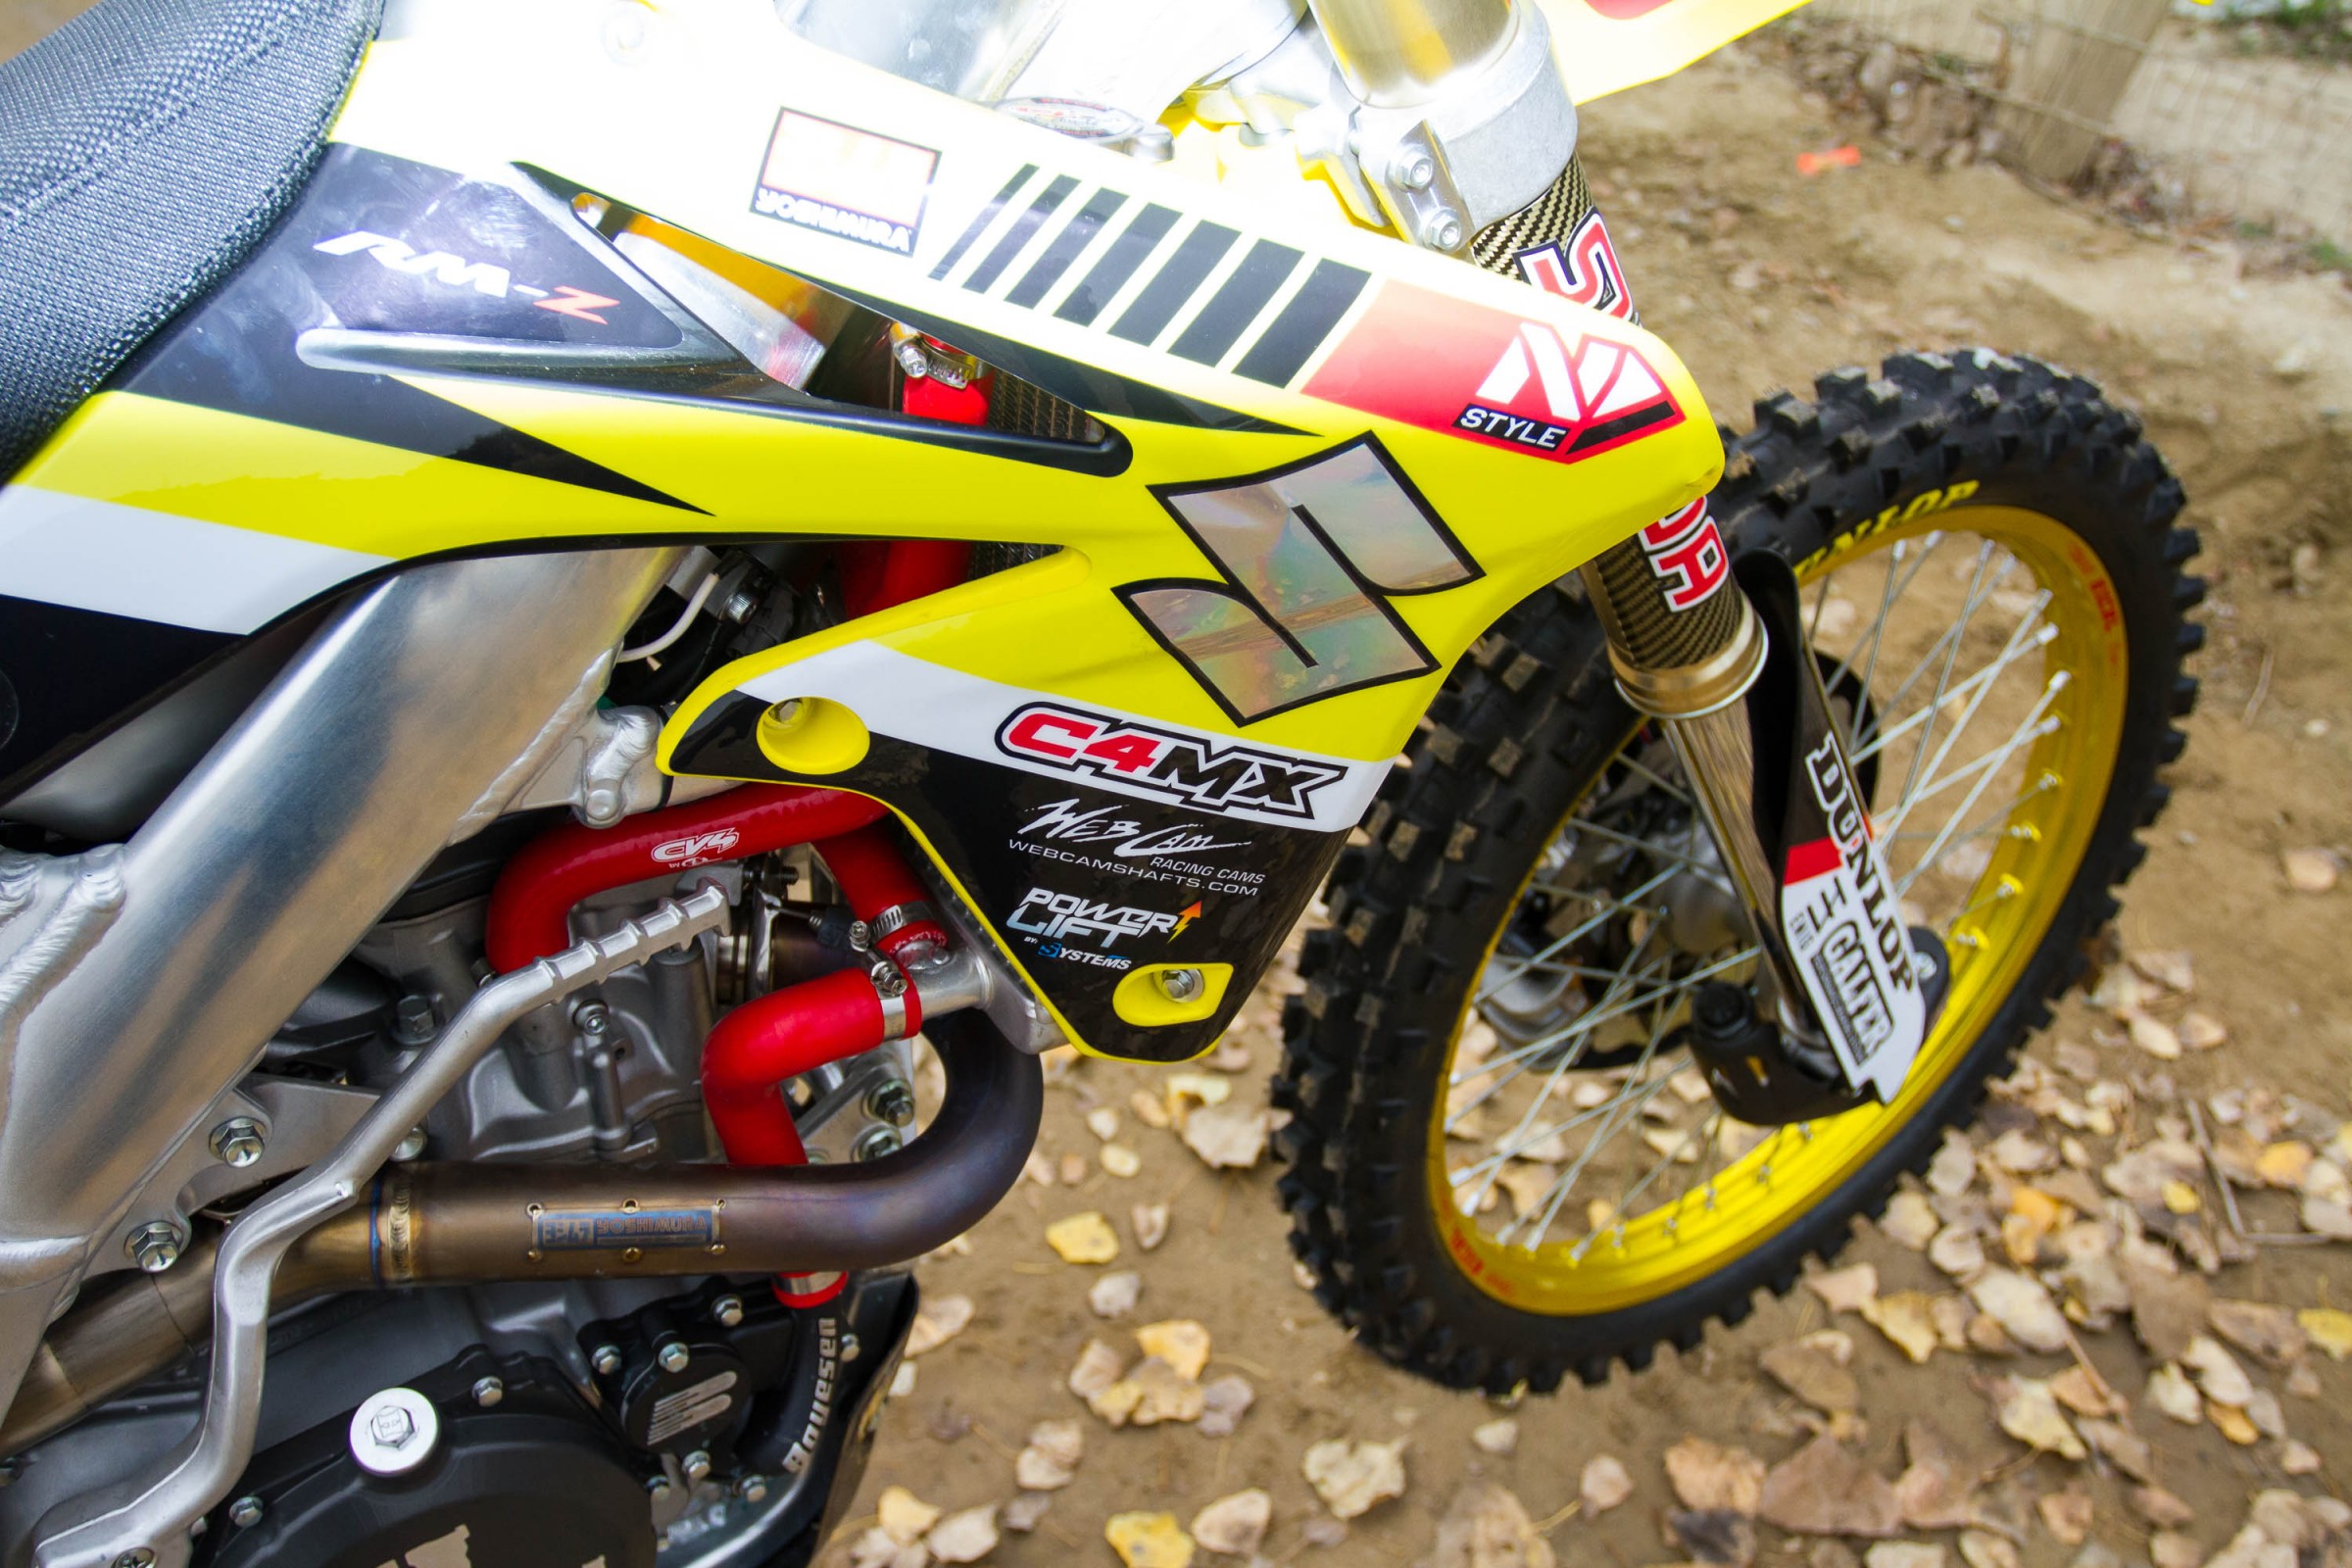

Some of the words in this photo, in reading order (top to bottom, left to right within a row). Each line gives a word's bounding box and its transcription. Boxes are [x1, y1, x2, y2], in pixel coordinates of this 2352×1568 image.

[755, 186, 913, 253] YOSHIMURA
[313, 230, 620, 325] RM-Z
[1460, 407, 1567, 449] STYLE
[1793, 478, 1980, 578] UNLOP
[996, 702, 1348, 819] C4MX
[651, 827, 739, 862] CV4
[1008, 838, 1259, 897] WEBCAMSHAFTS.COM
[1150, 856, 1214, 877] RACING
[1217, 868, 1266, 885] CAMS
[1805, 730, 1914, 994] DUNLOP
[1005, 903, 1144, 949] LIFT
[1018, 887, 1178, 938] POWER
[596, 1215, 708, 1235] YOSHIMURA
[782, 1317, 838, 1474] Boyesen
